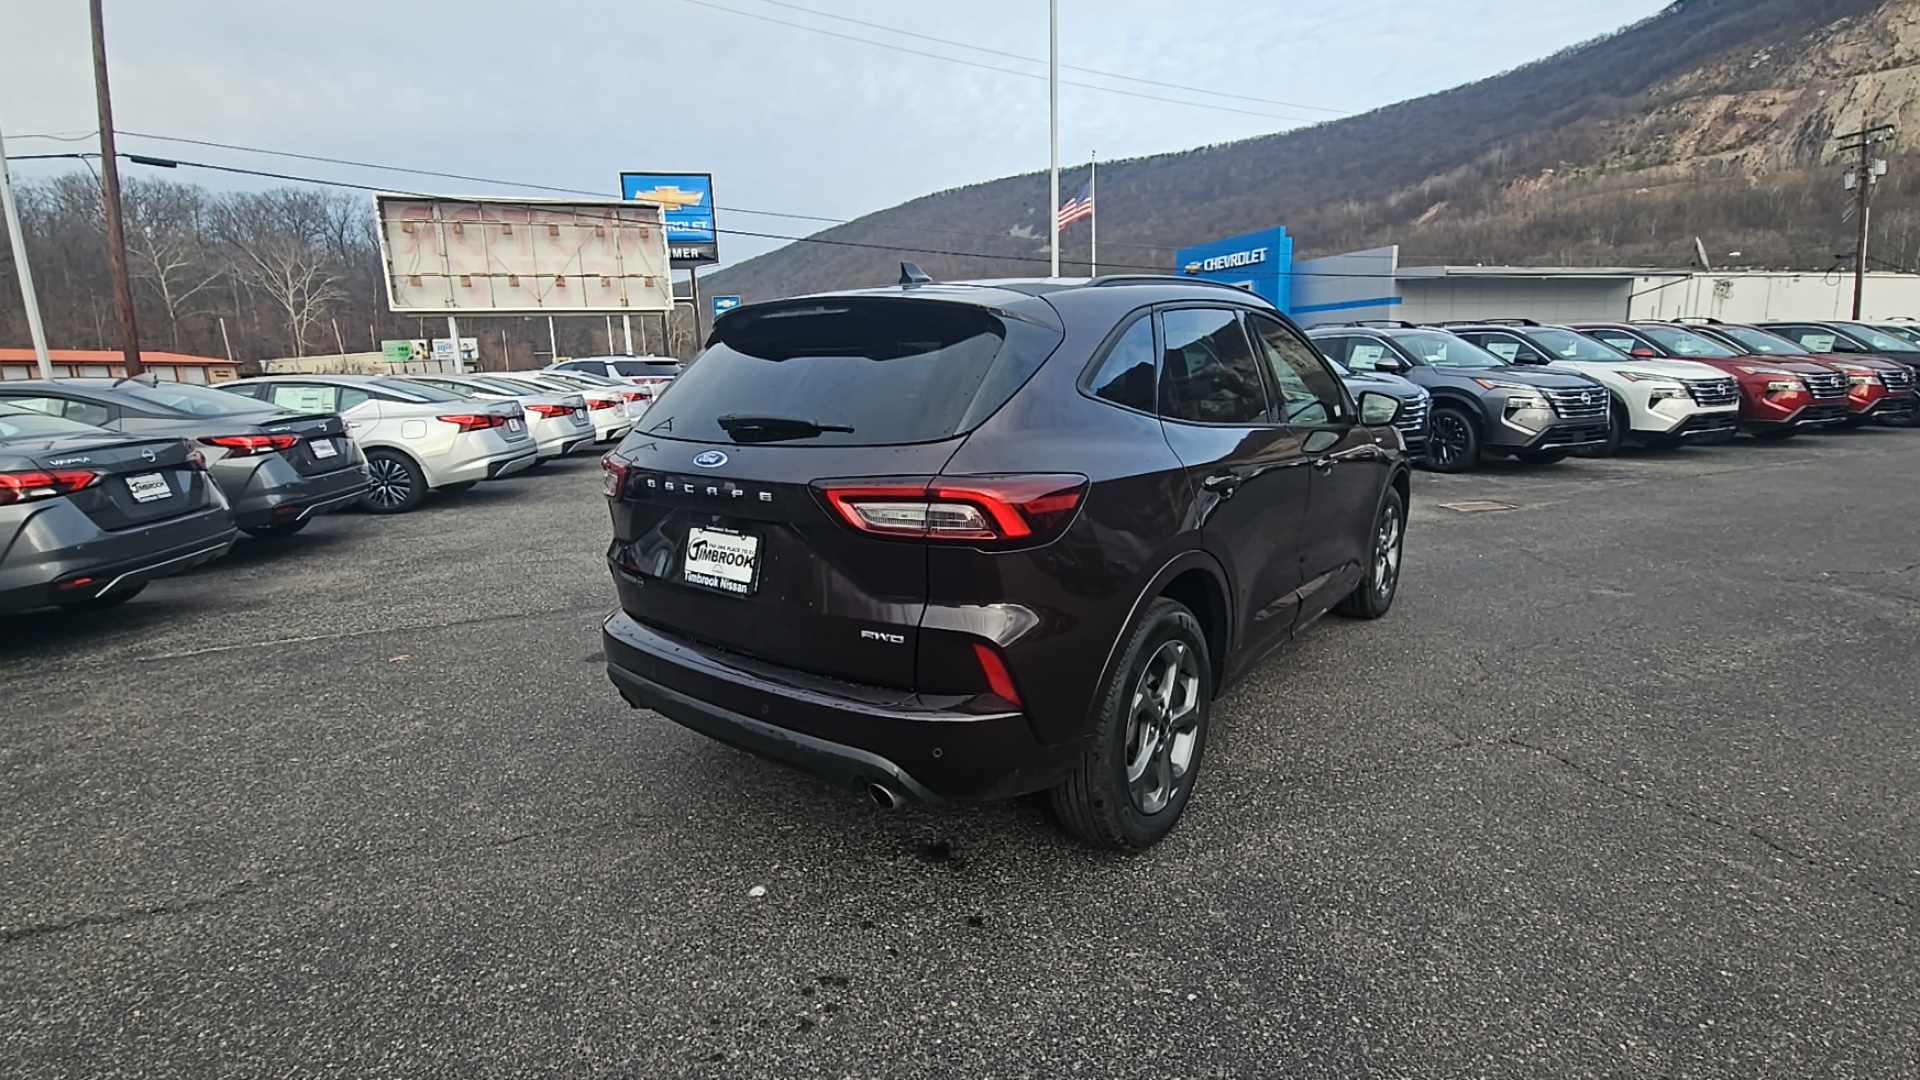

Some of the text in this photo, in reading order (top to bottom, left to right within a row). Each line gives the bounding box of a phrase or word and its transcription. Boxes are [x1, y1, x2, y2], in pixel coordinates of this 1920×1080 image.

[665, 220, 708, 232] ROLET
[669, 247, 699, 259] MER
[1204, 247, 1268, 272] CHEVROLET
[646, 478, 773, 502] ESCAPE
[688, 537, 755, 568] TIMBROOK
[684, 571, 747, 594] Timbrook Nissan
[861, 630, 905, 643] AWD
